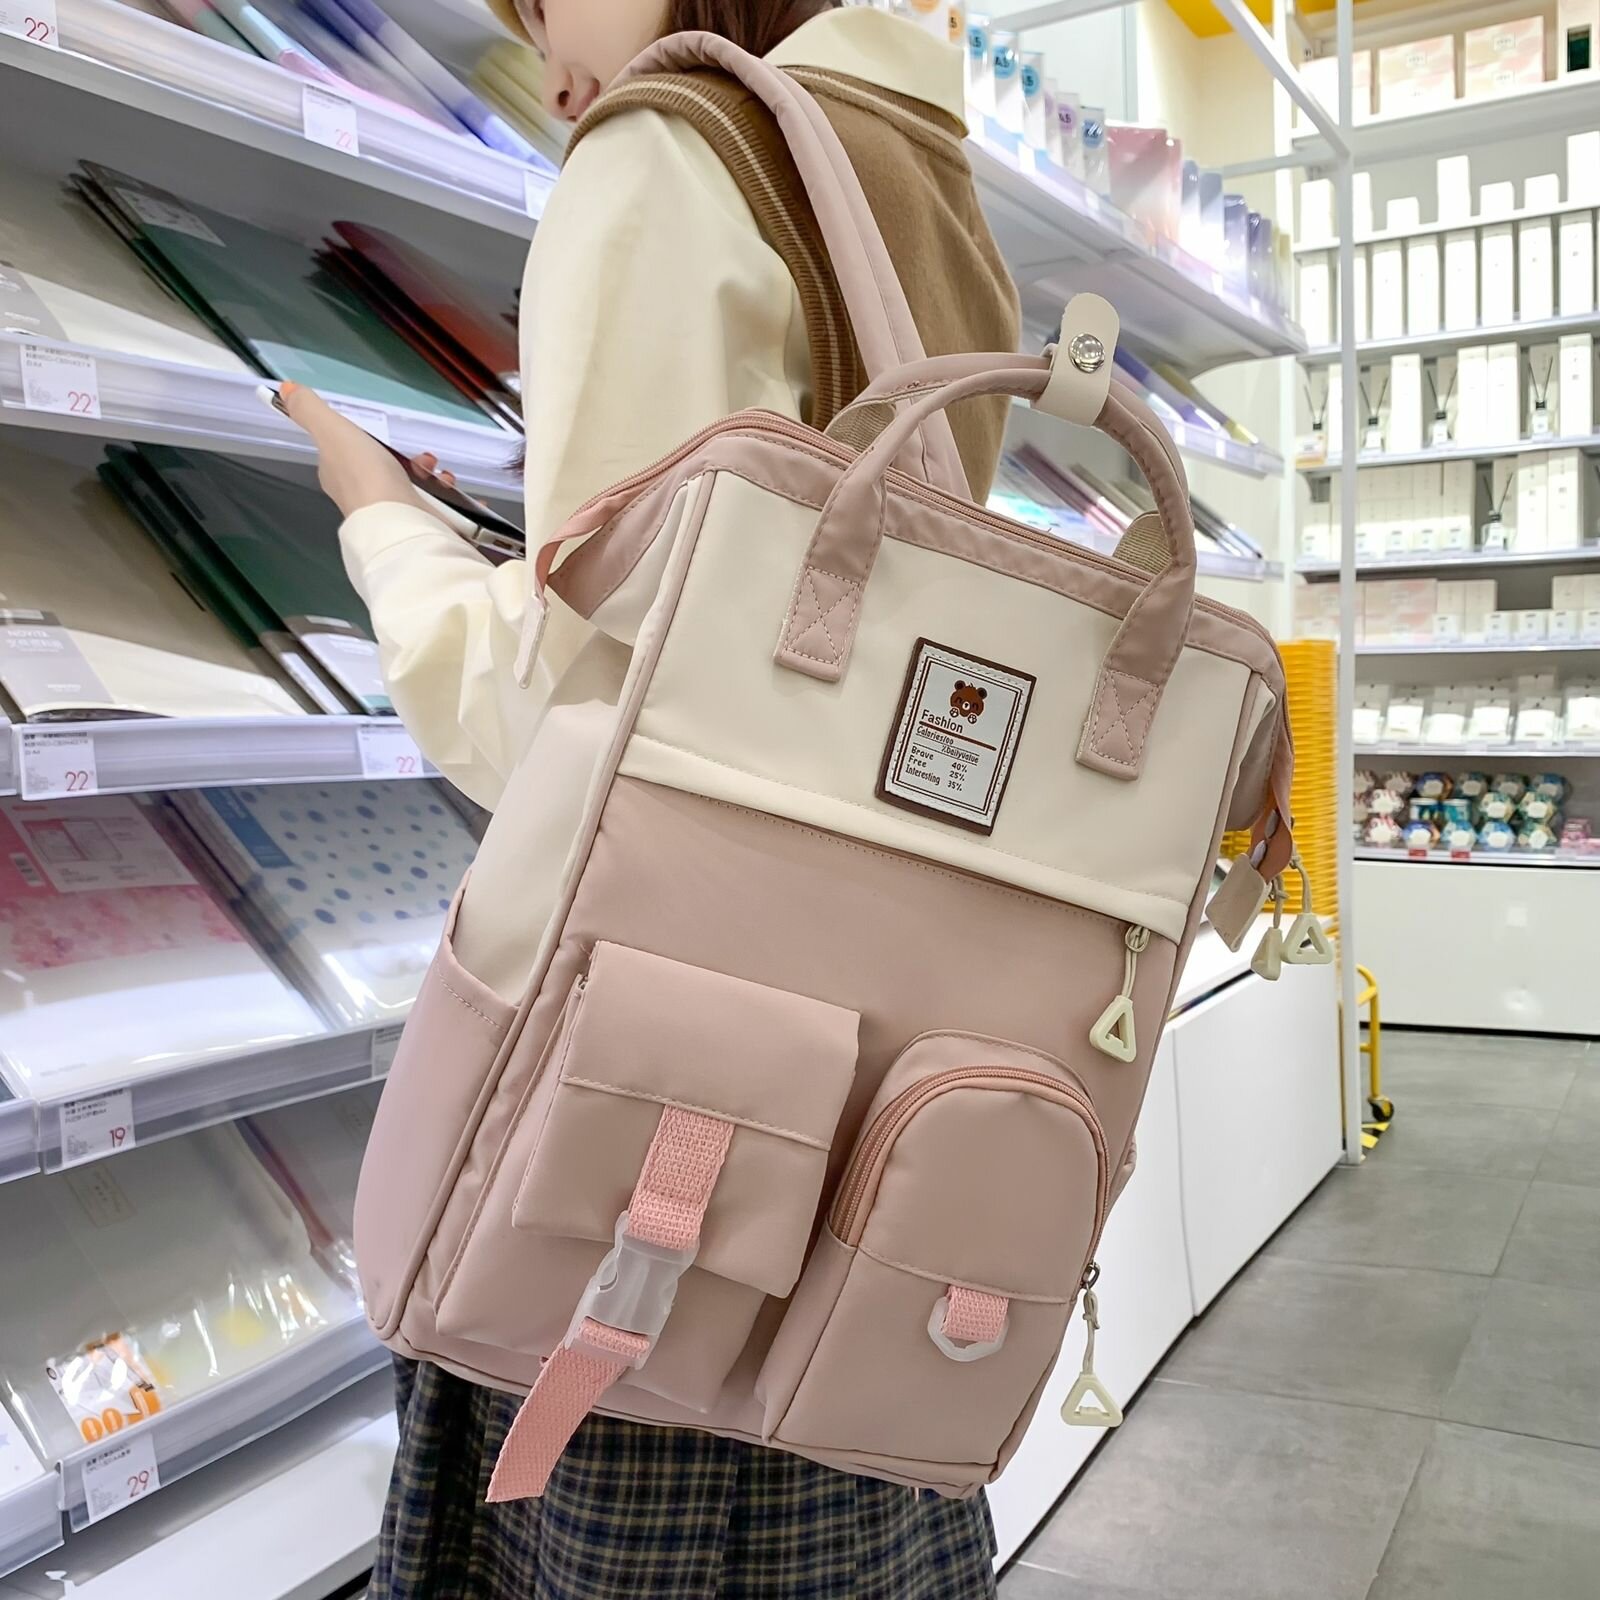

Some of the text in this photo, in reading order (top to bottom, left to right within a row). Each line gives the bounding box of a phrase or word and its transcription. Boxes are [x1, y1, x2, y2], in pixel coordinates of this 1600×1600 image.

[24, 17, 50, 45] 22
[67, 391, 93, 414] 22
[921, 709, 964, 733] Fashion
[908, 754, 965, 781] Free 25%
[911, 745, 968, 773] Brave 40%
[65, 770, 89, 792] 22
[905, 764, 963, 792] Interesting 35%
[109, 1127, 126, 1149] 19
[127, 1470, 150, 1498] 29
